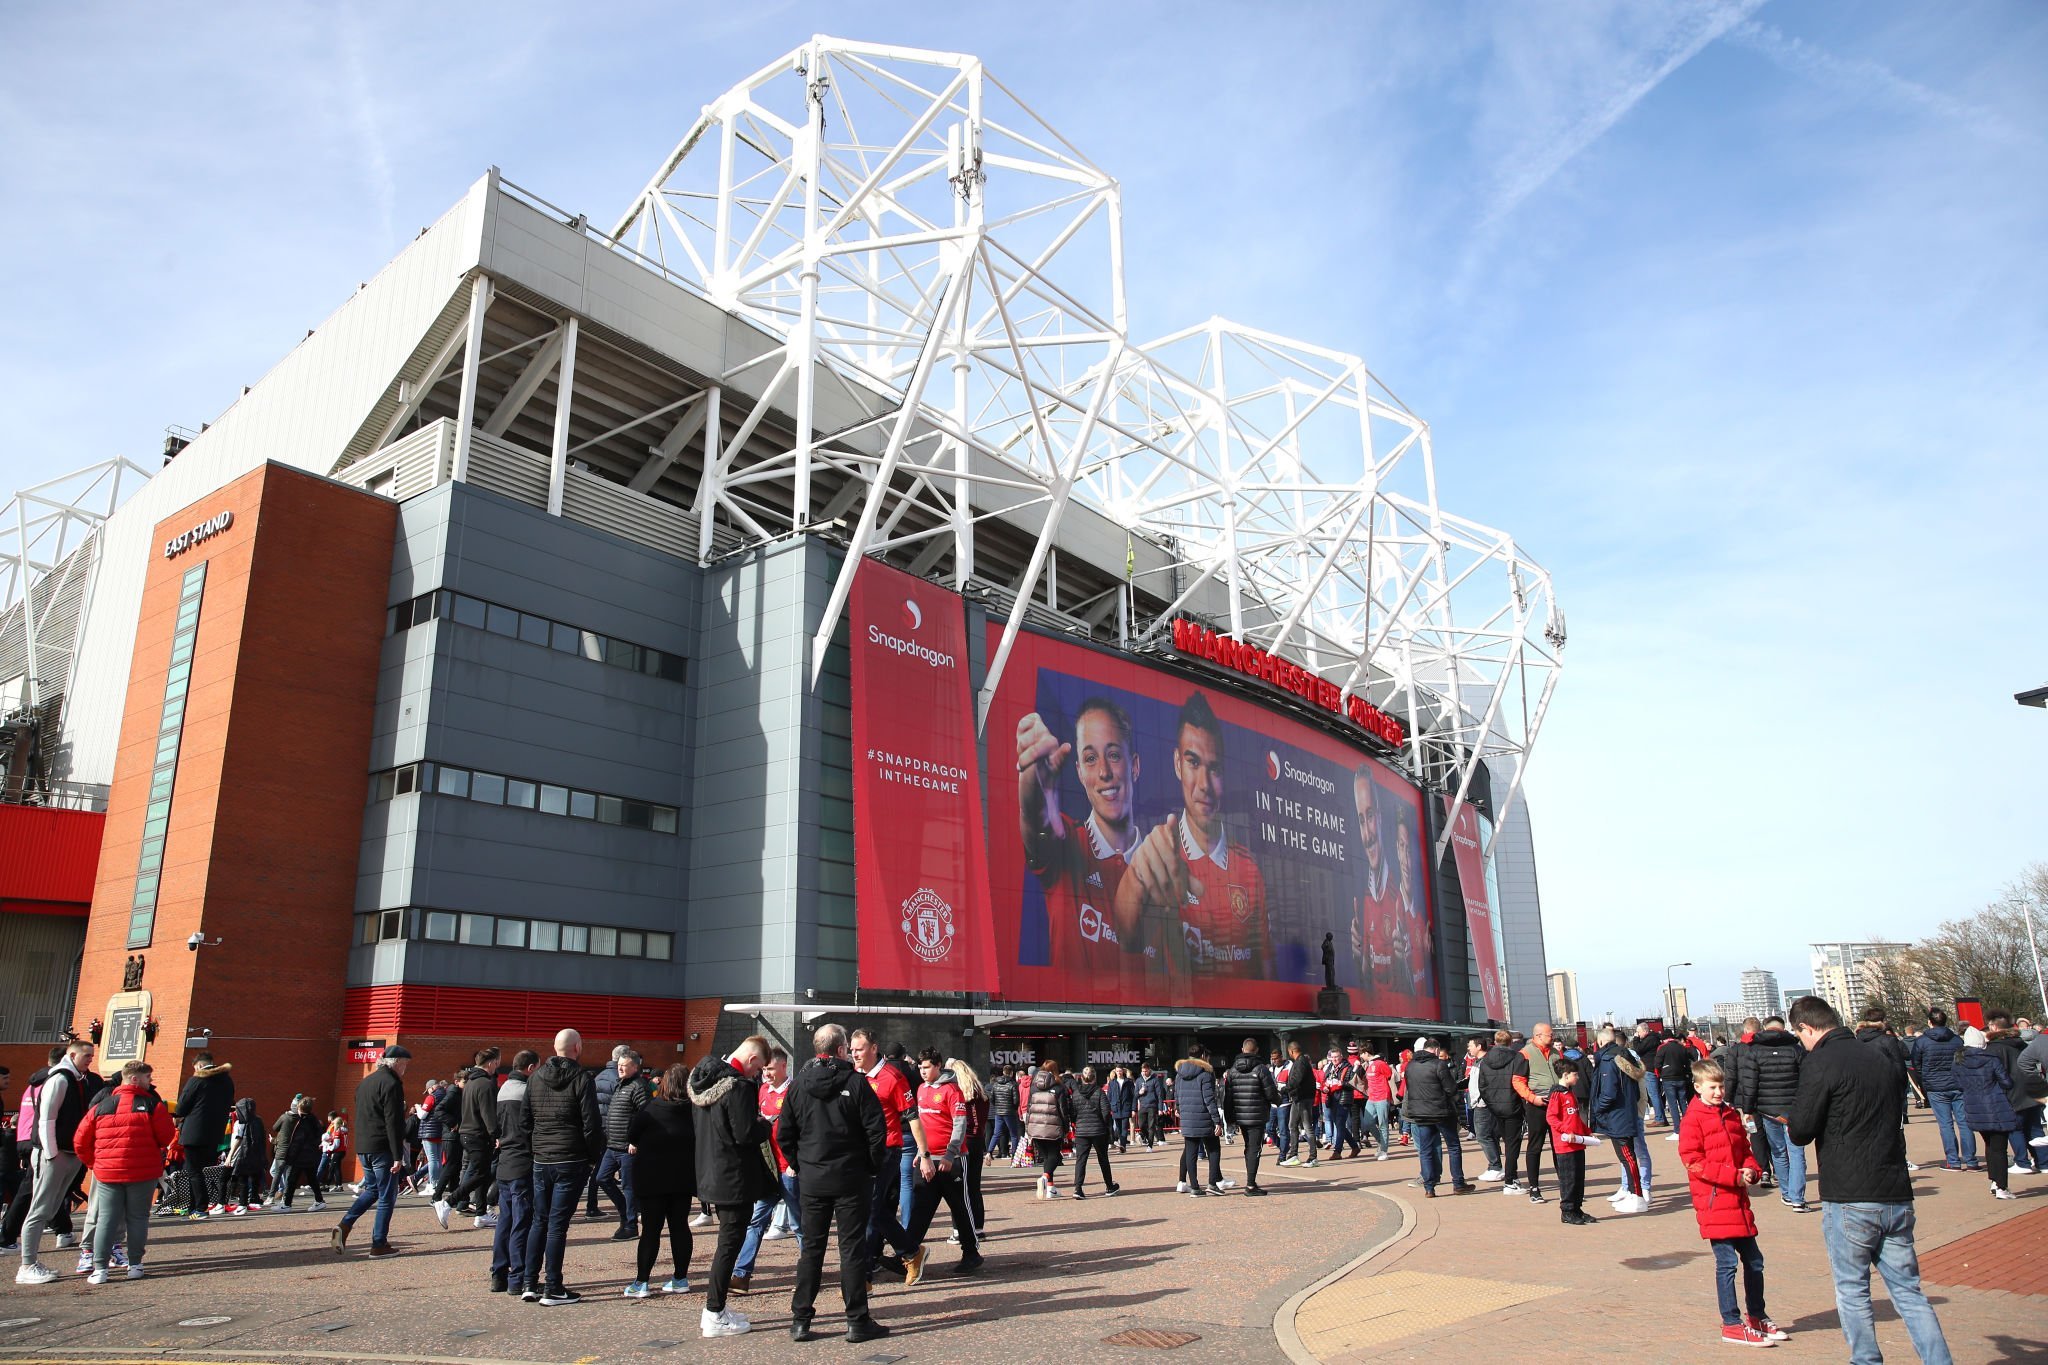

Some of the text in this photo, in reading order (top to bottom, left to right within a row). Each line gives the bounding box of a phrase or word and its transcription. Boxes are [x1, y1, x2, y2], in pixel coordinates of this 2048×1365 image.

[164, 510, 234, 559] EAST STAND
[868, 625, 954, 668] Snapdragon
[1173, 617, 1404, 748] MANCHESTER UNITED
[867, 749, 968, 780] #SNAPDRAGON
[879, 767, 959, 794] INTHEGAME
[1284, 761, 1335, 794] Snapdragon
[1255, 790, 1346, 835] IN THE FRAME
[1261, 822, 1345, 862] IN THE GAME
[906, 893, 950, 919] MANCHESTER
[915, 944, 945, 957] UNITED
[1087, 1050, 1141, 1064] ENTRANCE
